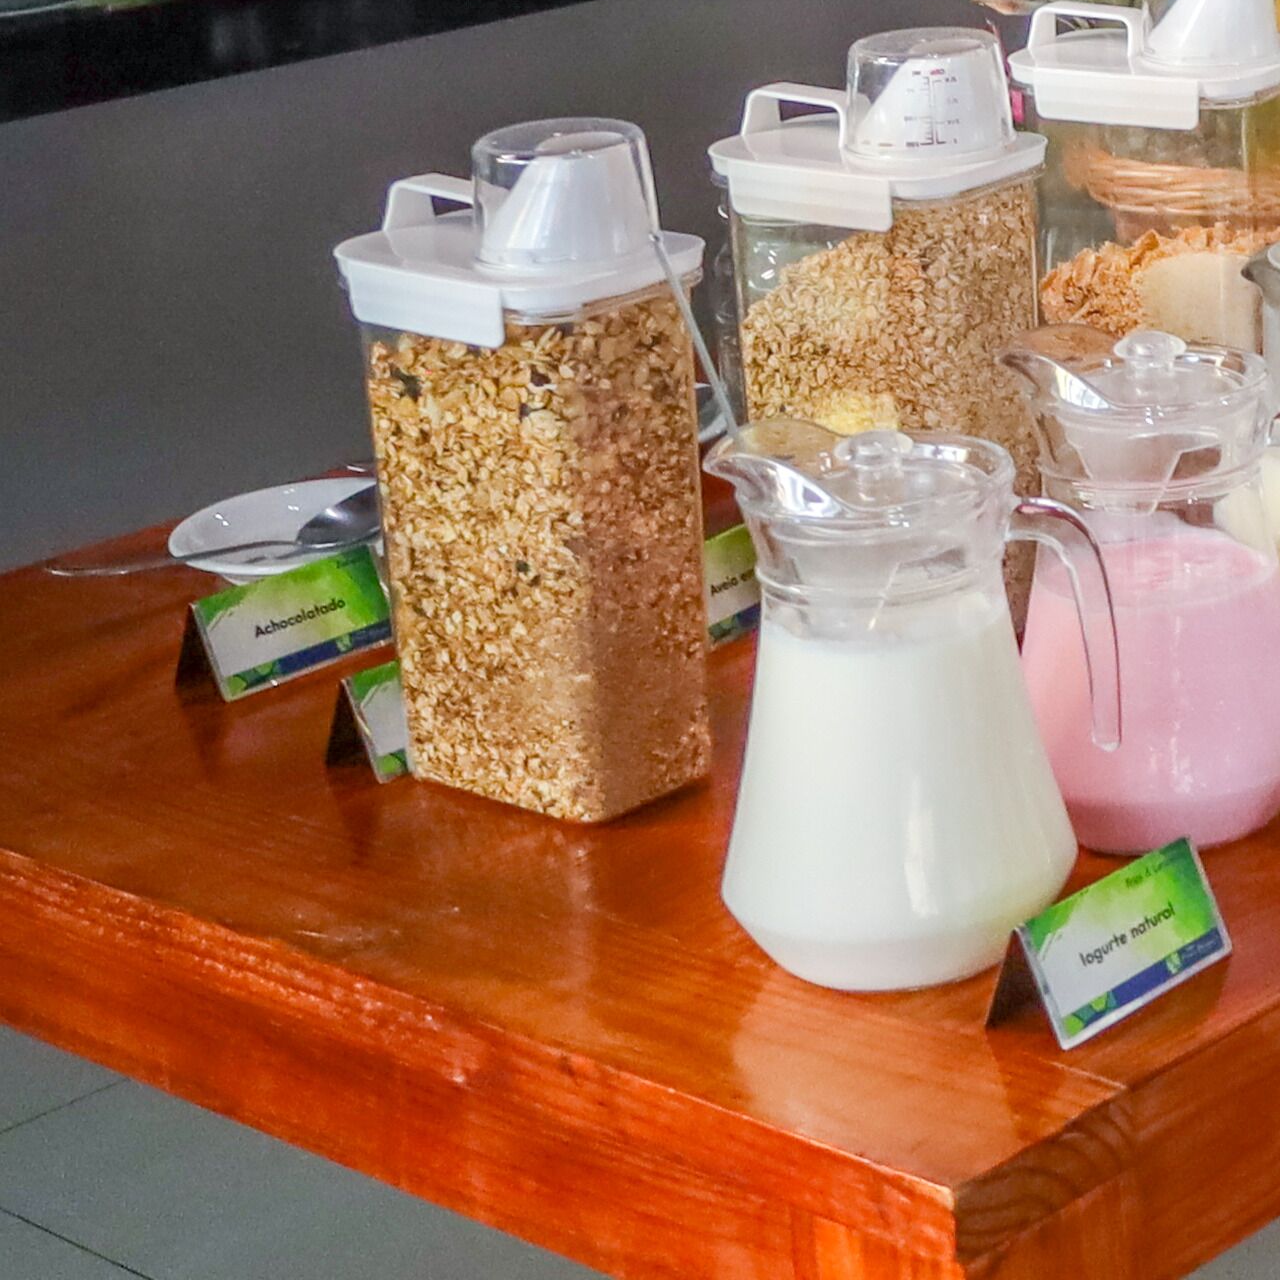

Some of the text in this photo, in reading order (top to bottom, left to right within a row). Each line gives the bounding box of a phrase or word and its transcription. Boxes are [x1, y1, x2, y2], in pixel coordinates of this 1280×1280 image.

[711, 575, 739, 597] Aveia
[254, 598, 347, 639] Achocolatado
[1079, 899, 1176, 968] Iogurte natural
